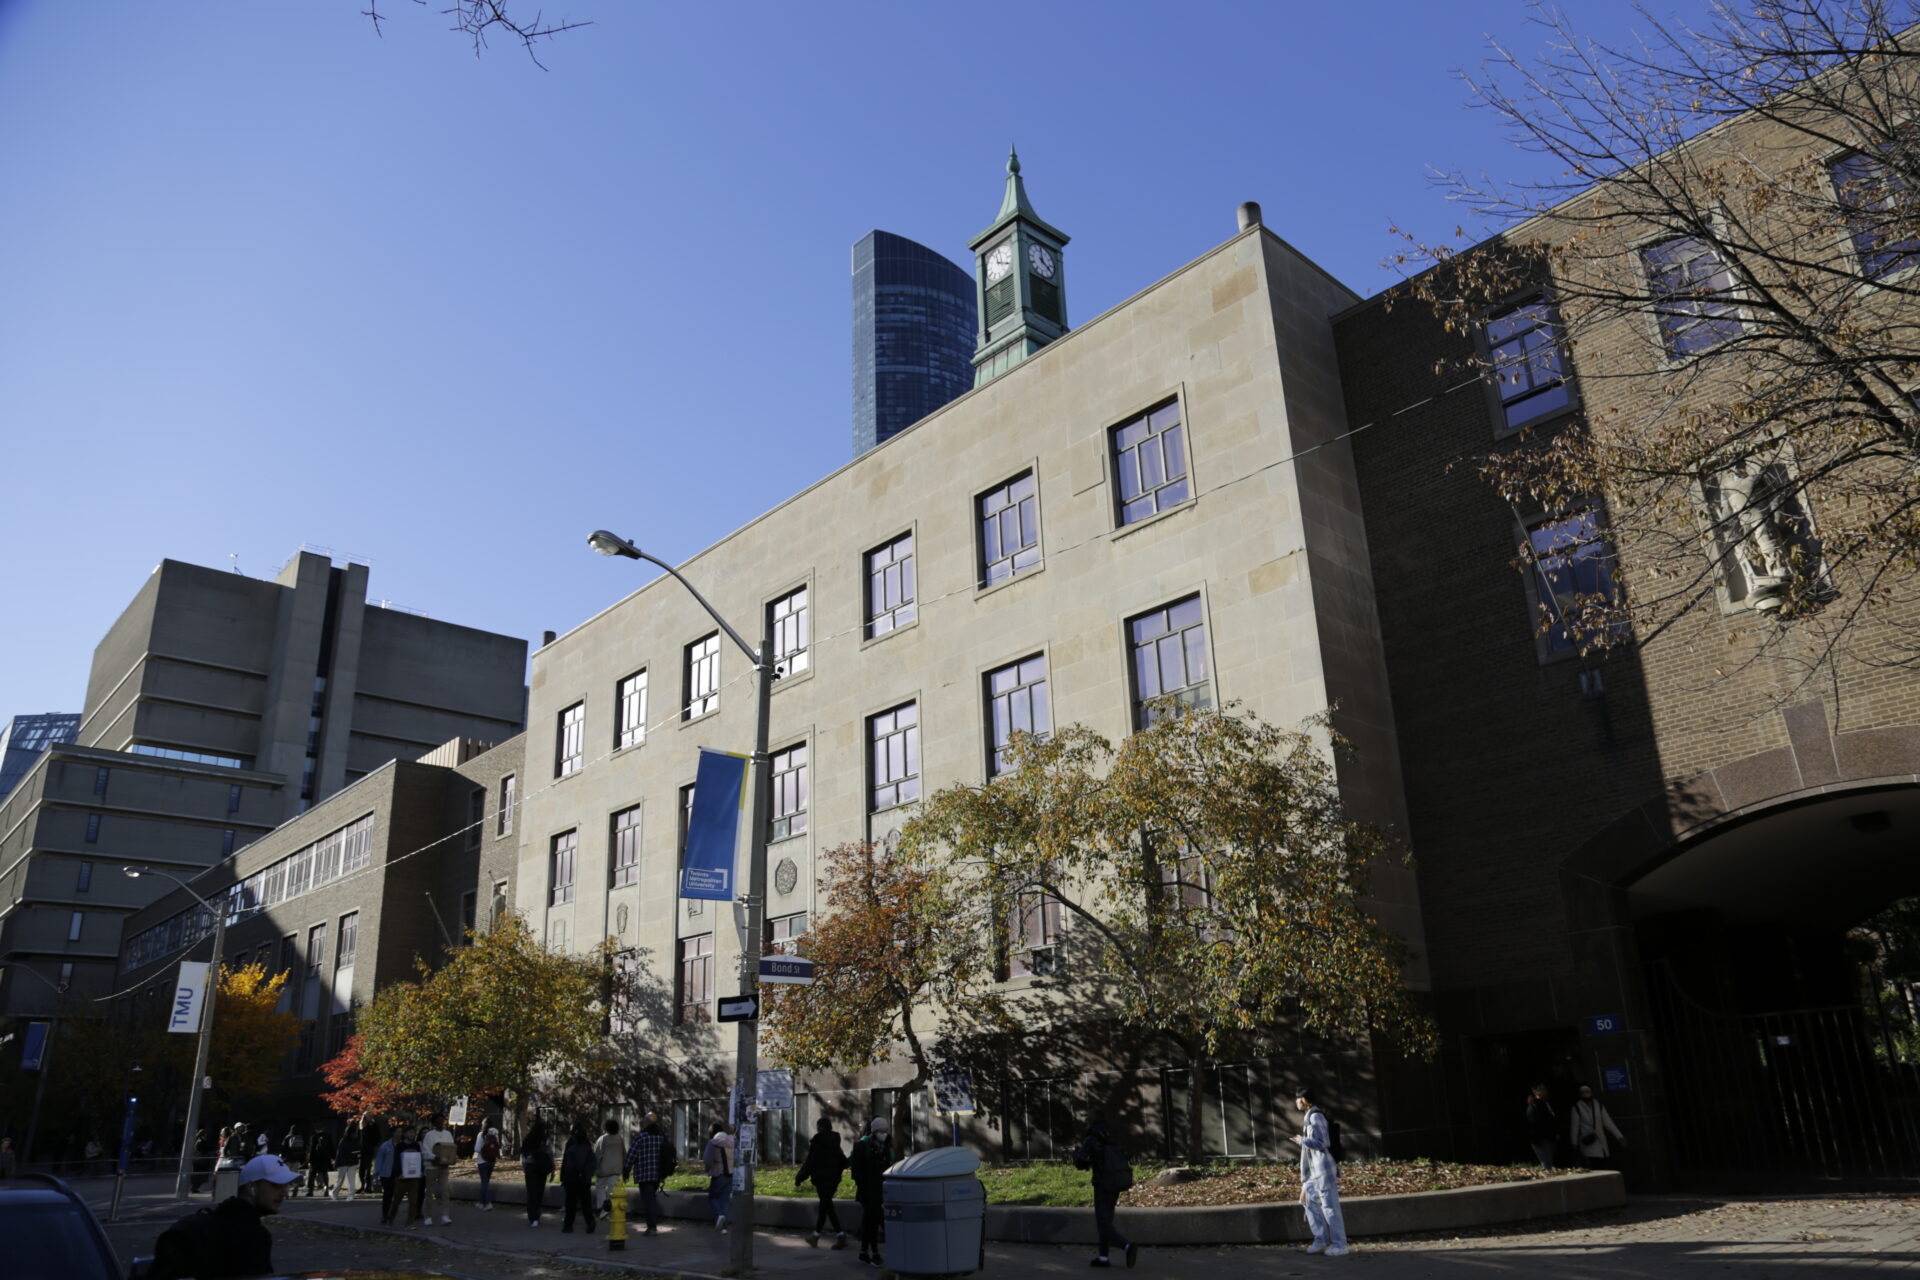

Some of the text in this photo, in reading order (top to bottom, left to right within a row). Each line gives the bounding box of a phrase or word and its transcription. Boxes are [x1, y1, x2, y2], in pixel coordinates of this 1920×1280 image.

[771, 962, 792, 974] Bond
[171, 988, 194, 1028] TMU
[1596, 1019, 1612, 1031] 50
